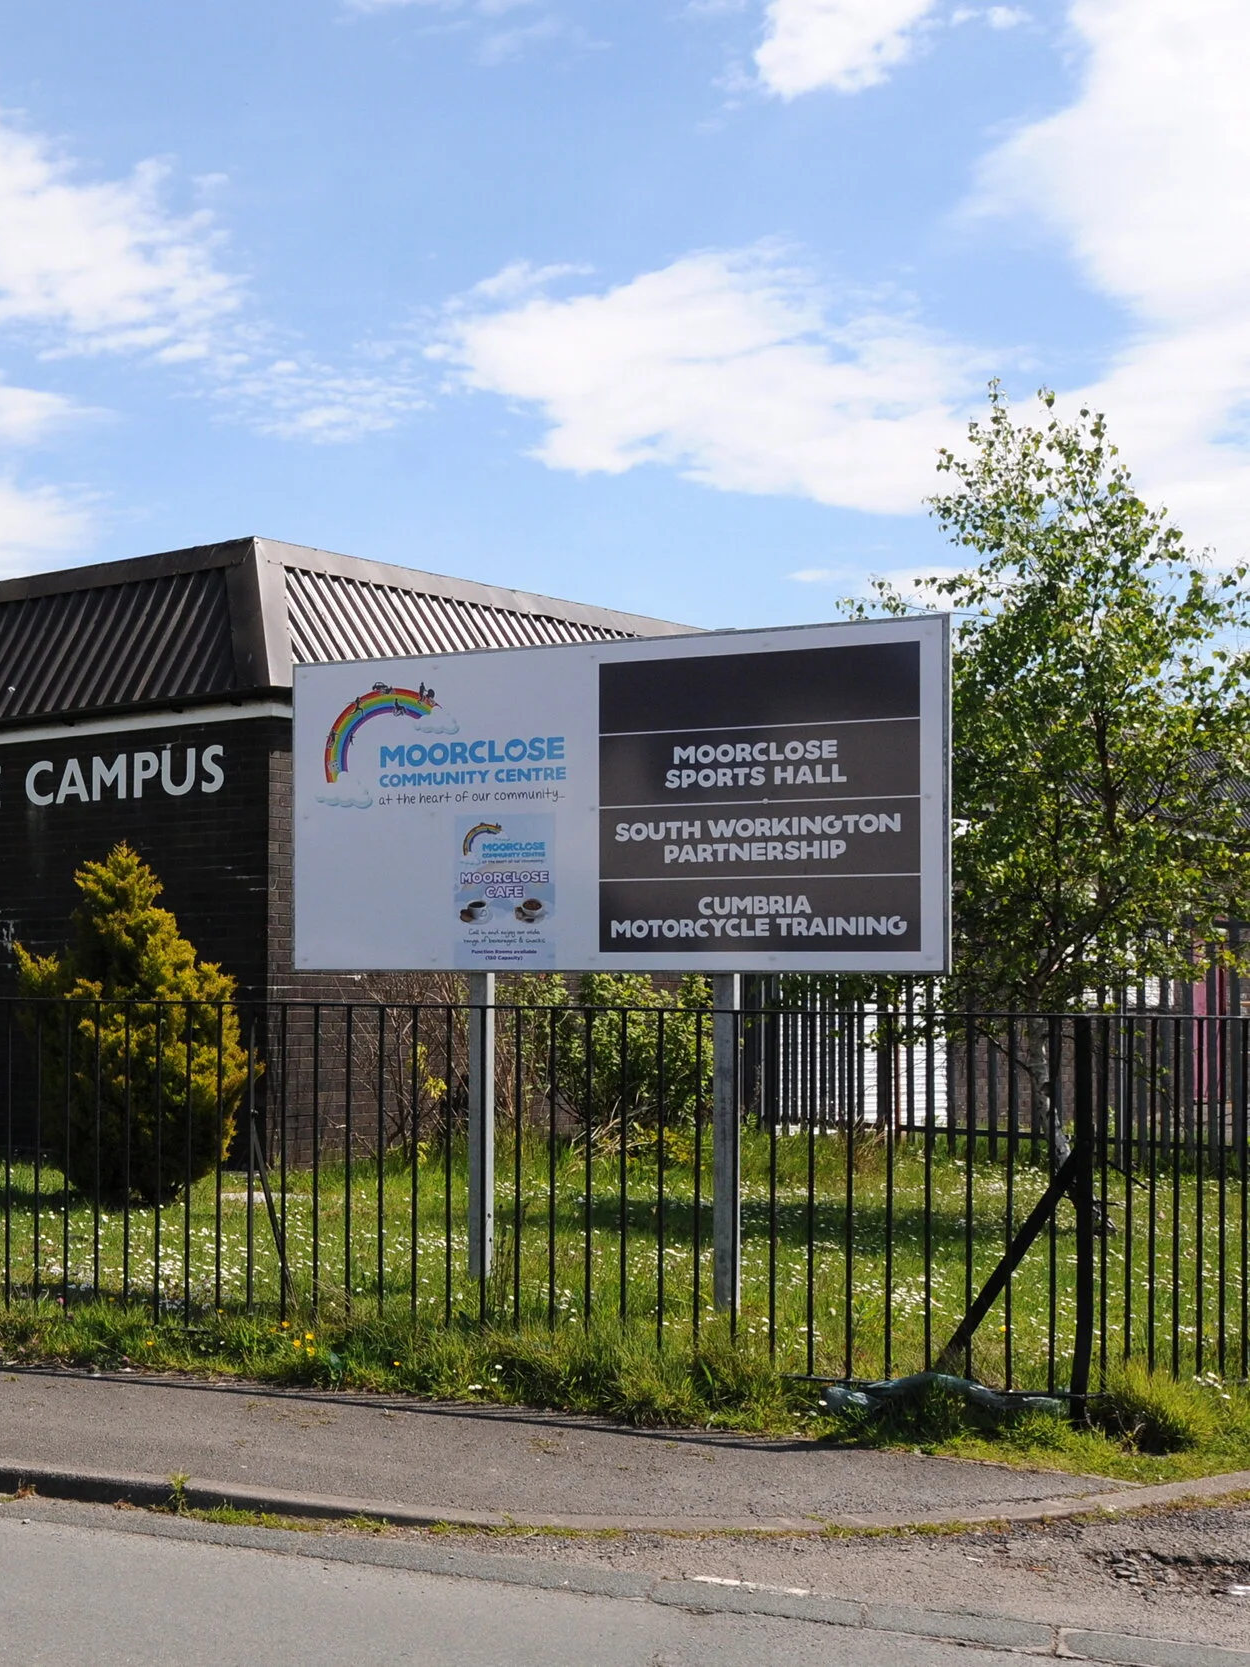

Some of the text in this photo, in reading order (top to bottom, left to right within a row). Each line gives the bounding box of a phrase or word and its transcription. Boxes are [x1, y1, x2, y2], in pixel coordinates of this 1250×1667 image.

[379, 737, 565, 769] MOORCLOSE
[673, 739, 838, 765] MOORCLOSE
[25, 744, 225, 806] CAMPUS
[379, 766, 567, 788] COMMUNITY CENTRE
[664, 764, 847, 789] SPORTS HALL
[378, 793, 392, 806] at
[396, 793, 416, 805] the
[419, 791, 452, 805] heart
[454, 790, 469, 802] of
[472, 792, 491, 803] our
[615, 813, 901, 842] SOUTH WORKINGTON
[482, 842, 546, 852] MOORCLOSE
[664, 839, 847, 864] PARTNERSHIP
[460, 871, 549, 884] MOORCLOSE
[485, 886, 524, 898] CAFE
[698, 895, 812, 916] CUMBRIA
[610, 916, 908, 938] MOTORCYCLE TRAINING
